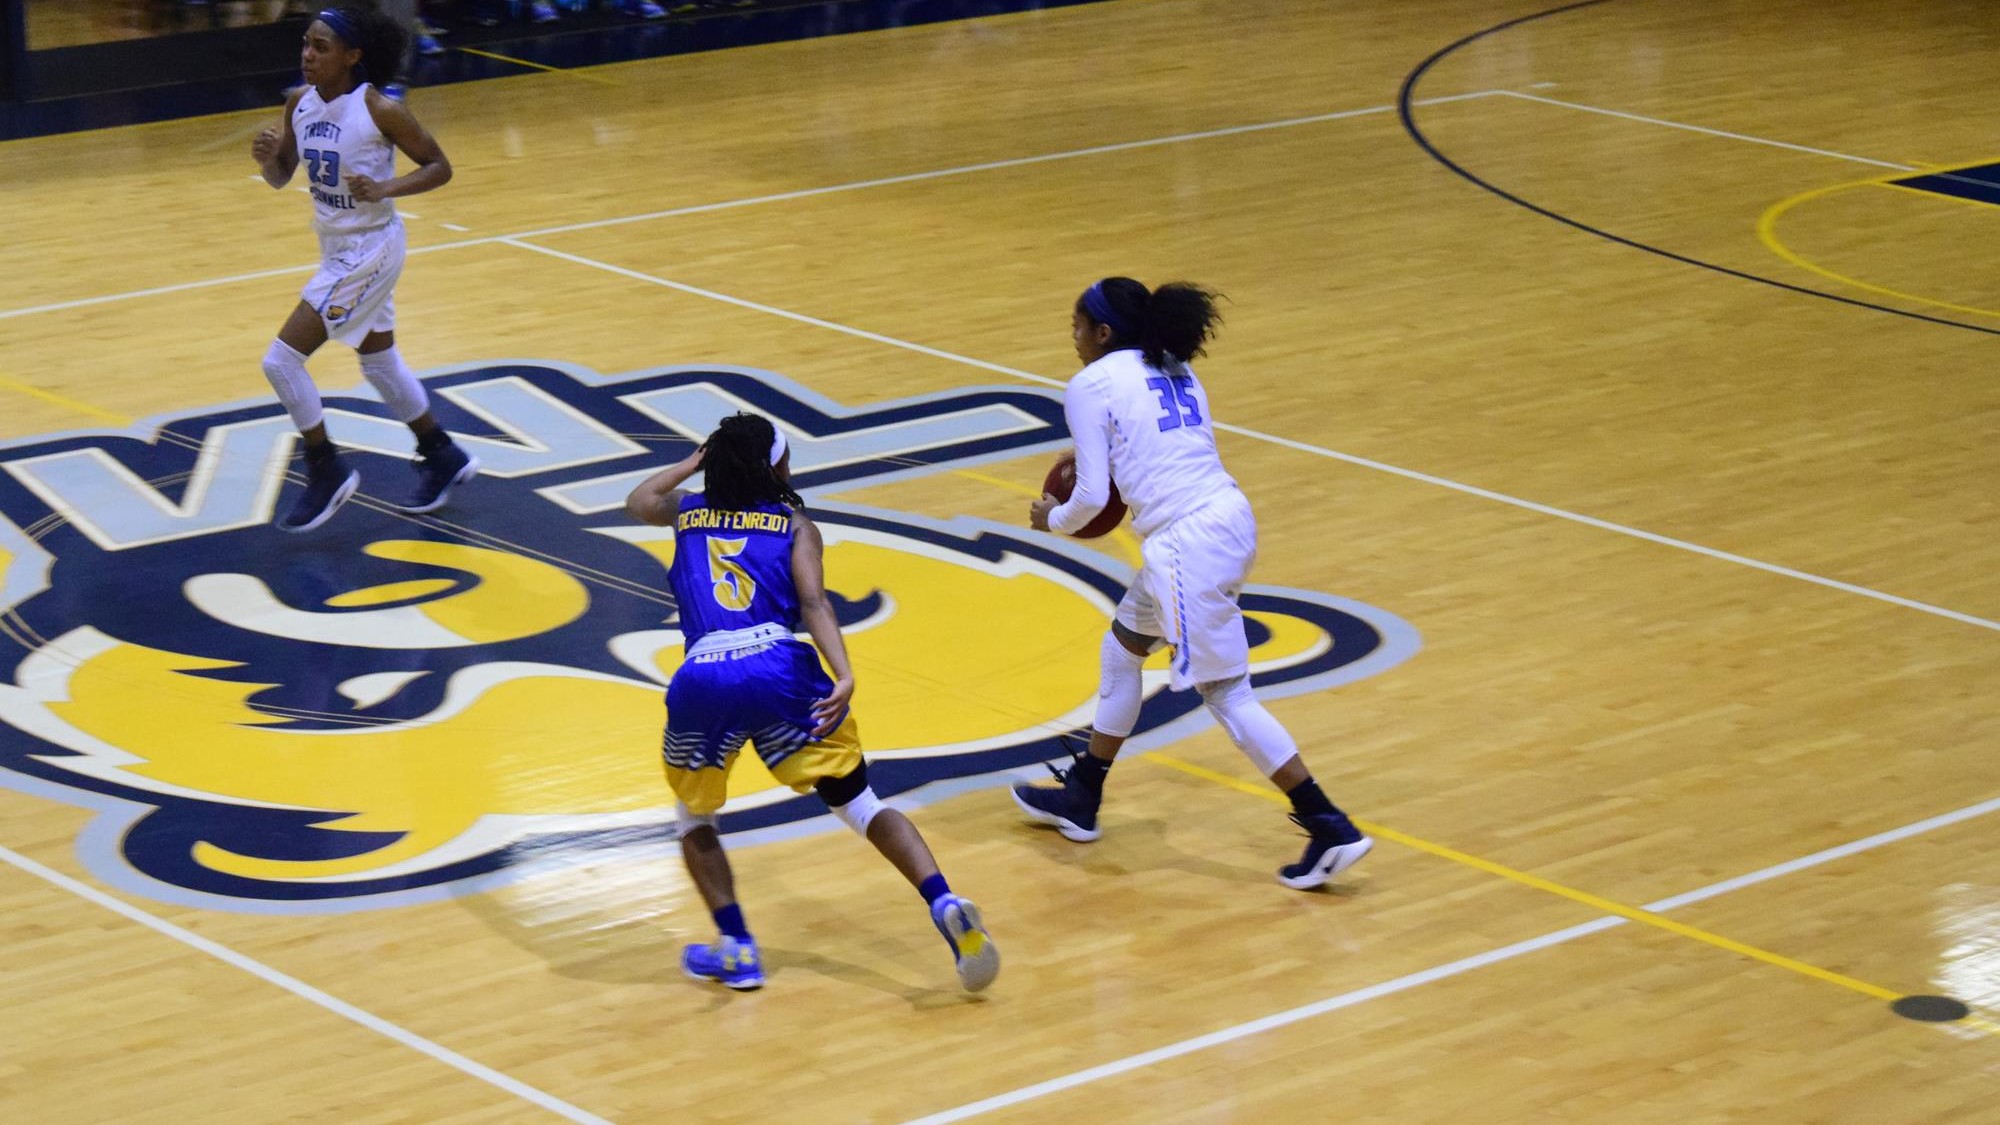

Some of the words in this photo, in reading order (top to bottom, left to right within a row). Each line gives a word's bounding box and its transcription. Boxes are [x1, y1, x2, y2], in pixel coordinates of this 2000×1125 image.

[304, 149, 340, 187] 23
[1146, 376, 1202, 432] 35
[706, 535, 756, 611] 5
